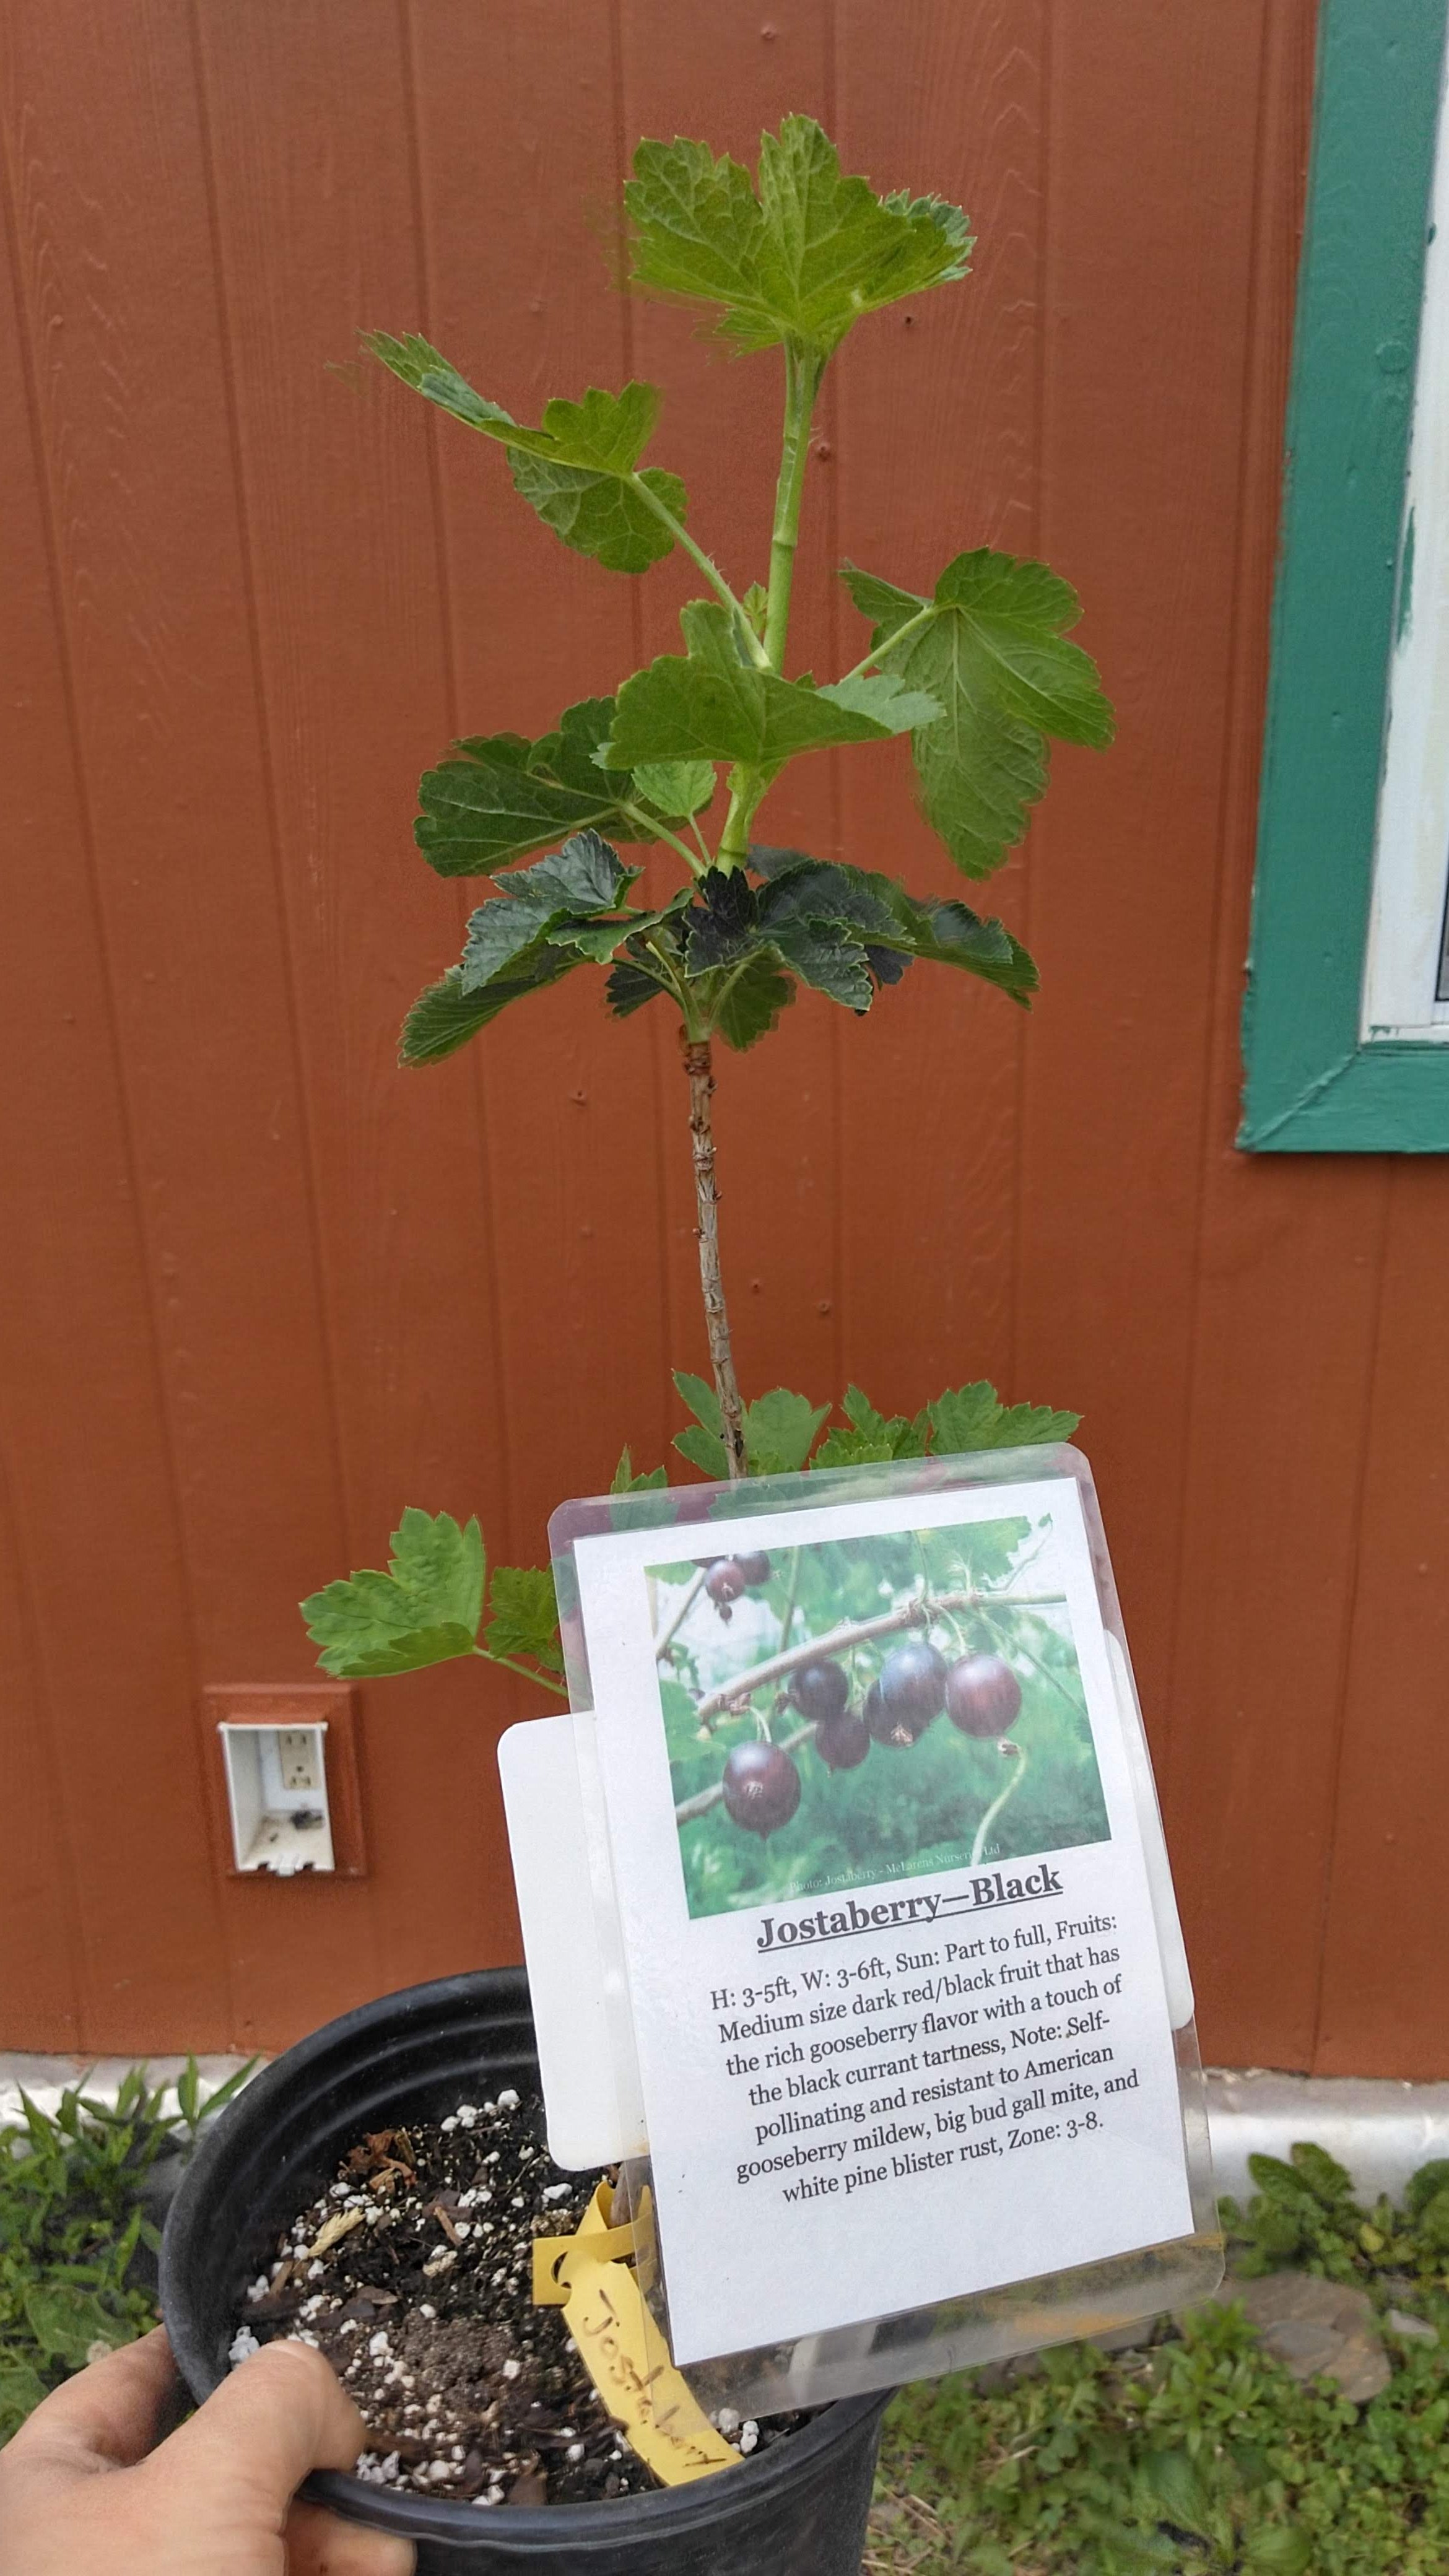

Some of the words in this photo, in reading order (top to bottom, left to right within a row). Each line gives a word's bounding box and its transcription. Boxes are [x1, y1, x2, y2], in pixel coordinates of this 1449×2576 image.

[710, 1988, 736, 2011] H:
[742, 1975, 798, 2008] 3-5ft,
[800, 1969, 831, 1991] W:
[837, 1957, 891, 1989] 3-6ft,
[895, 1951, 940, 1972] Sun:
[944, 1939, 986, 1963] Part
[989, 1936, 1009, 1953] to
[1013, 1923, 1052, 1949] full,
[1055, 1914, 1117, 1941] Fruits:
[718, 2013, 805, 2044] Medium
[809, 2002, 848, 2025] size
[852, 1988, 899, 2016] dark
[902, 1968, 996, 2005] red/black
[998, 1959, 1043, 1985] fruit
[1045, 1952, 1085, 1975] that
[1086, 1946, 1120, 1967] has
[725, 2053, 760, 2076] the
[764, 2042, 805, 2069] rich
[809, 2022, 918, 2064] gooseberry
[921, 2009, 979, 2035] flavor
[982, 1995, 1026, 2021] with
[1030, 1997, 1043, 2011] a
[1045, 1979, 1099, 2008] touch
[1103, 1973, 1122, 1995] of
[748, 2083, 783, 2106] the
[785, 2068, 842, 2098] black
[845, 2053, 920, 2085] currant
[921, 2039, 1006, 2068] tartness,
[1009, 2026, 1063, 2049] Note:
[1066, 2010, 1110, 2037] Self-
[736, 2141, 848, 2185] gooseberry
[852, 2122, 931, 2152] mildew,
[933, 2110, 967, 2134] big
[968, 2097, 1008, 2125] bud
[1012, 2088, 1046, 2120] gall
[1050, 2082, 1099, 2106] mite,
[1103, 2068, 1140, 2094] and
[754, 2102, 866, 2146] pollinating
[869, 2087, 908, 2114] and
[911, 2070, 995, 2105] resistant
[998, 2067, 1019, 2084] to
[1024, 2047, 1114, 2080] American
[781, 2175, 839, 2203] white
[843, 2165, 888, 2195] pine
[890, 2149, 954, 2178] blister
[959, 2136, 1004, 2161] rust,
[1007, 2125, 1061, 2150] Zone:
[1066, 2111, 1103, 2139] 3-8.
